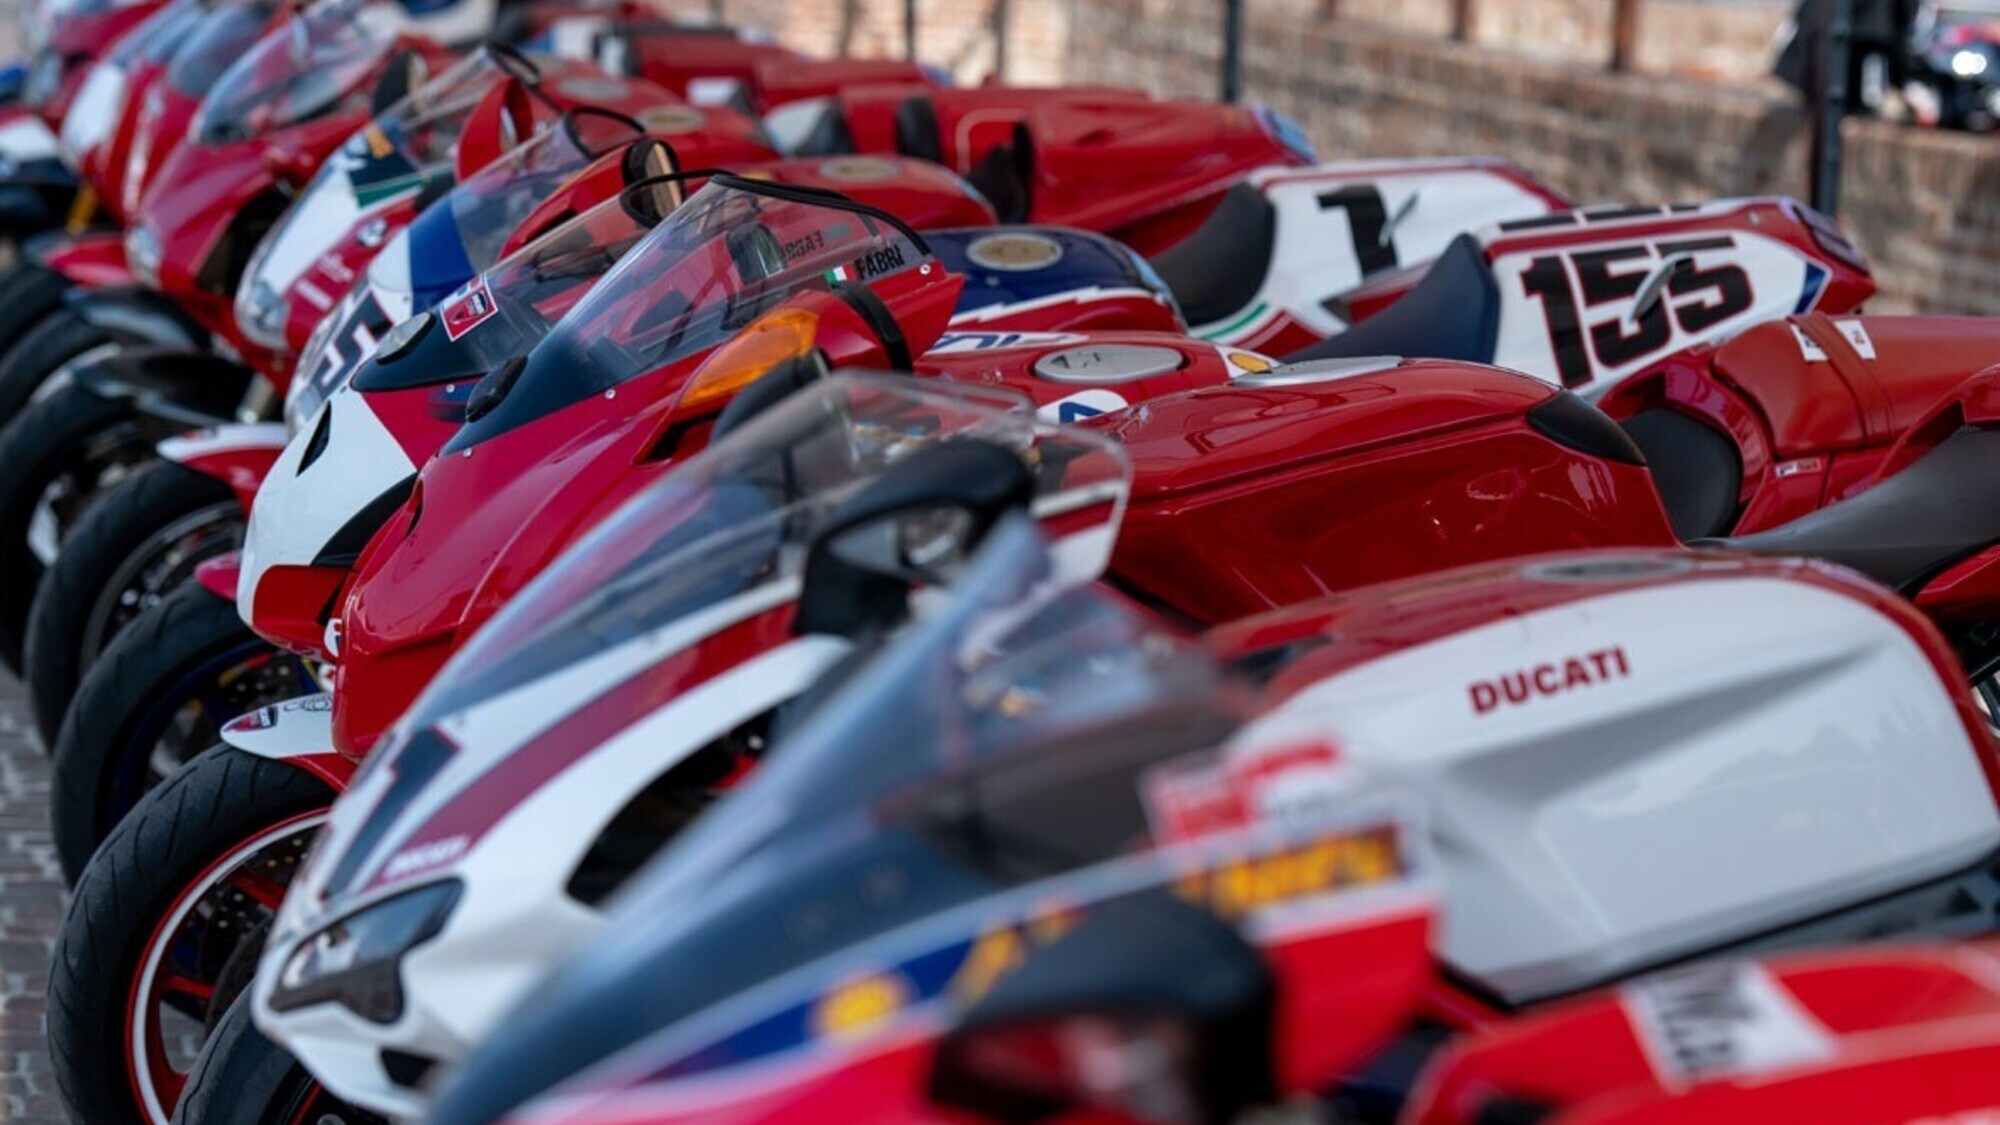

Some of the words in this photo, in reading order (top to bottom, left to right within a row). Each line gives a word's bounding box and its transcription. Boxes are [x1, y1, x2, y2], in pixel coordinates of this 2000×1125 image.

[854, 244, 904, 280] FABRI
[1317, 184, 1398, 277] 1
[1519, 236, 1754, 390] 155
[1468, 645, 1629, 716] DUCATI
